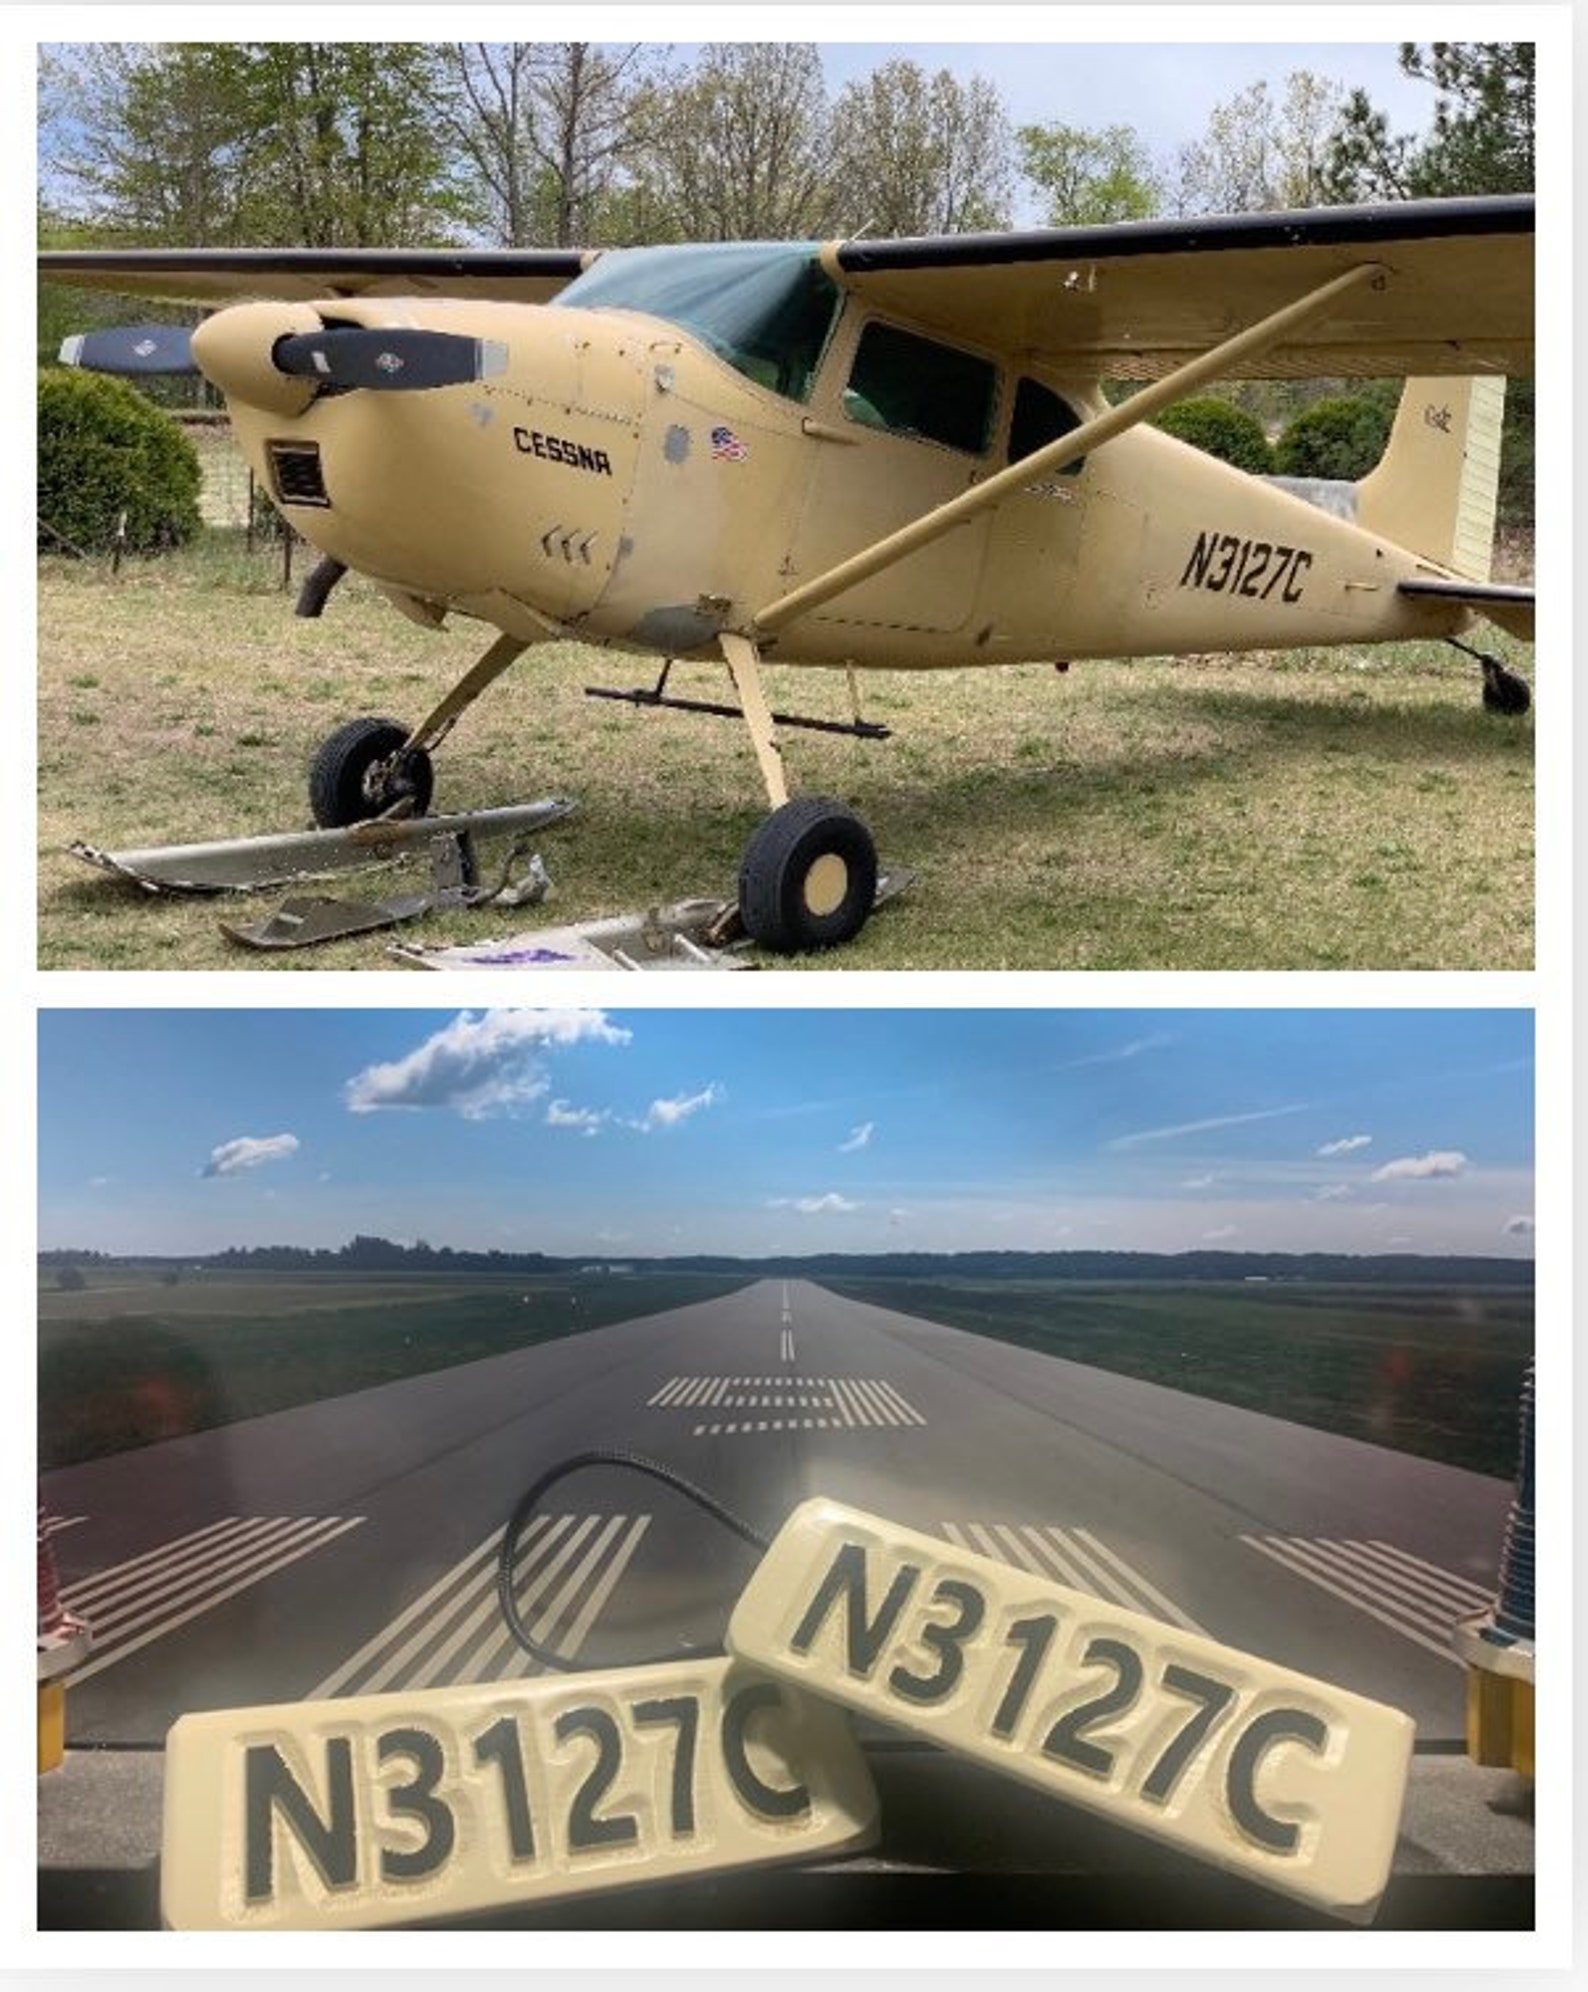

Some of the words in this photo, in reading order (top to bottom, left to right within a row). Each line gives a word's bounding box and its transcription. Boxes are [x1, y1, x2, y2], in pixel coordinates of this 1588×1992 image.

[513, 426, 612, 476] CESSNA
[1180, 531, 1312, 602] N3127C
[790, 1543, 1329, 1855] N3127C
[243, 1683, 812, 1902] N3127C
